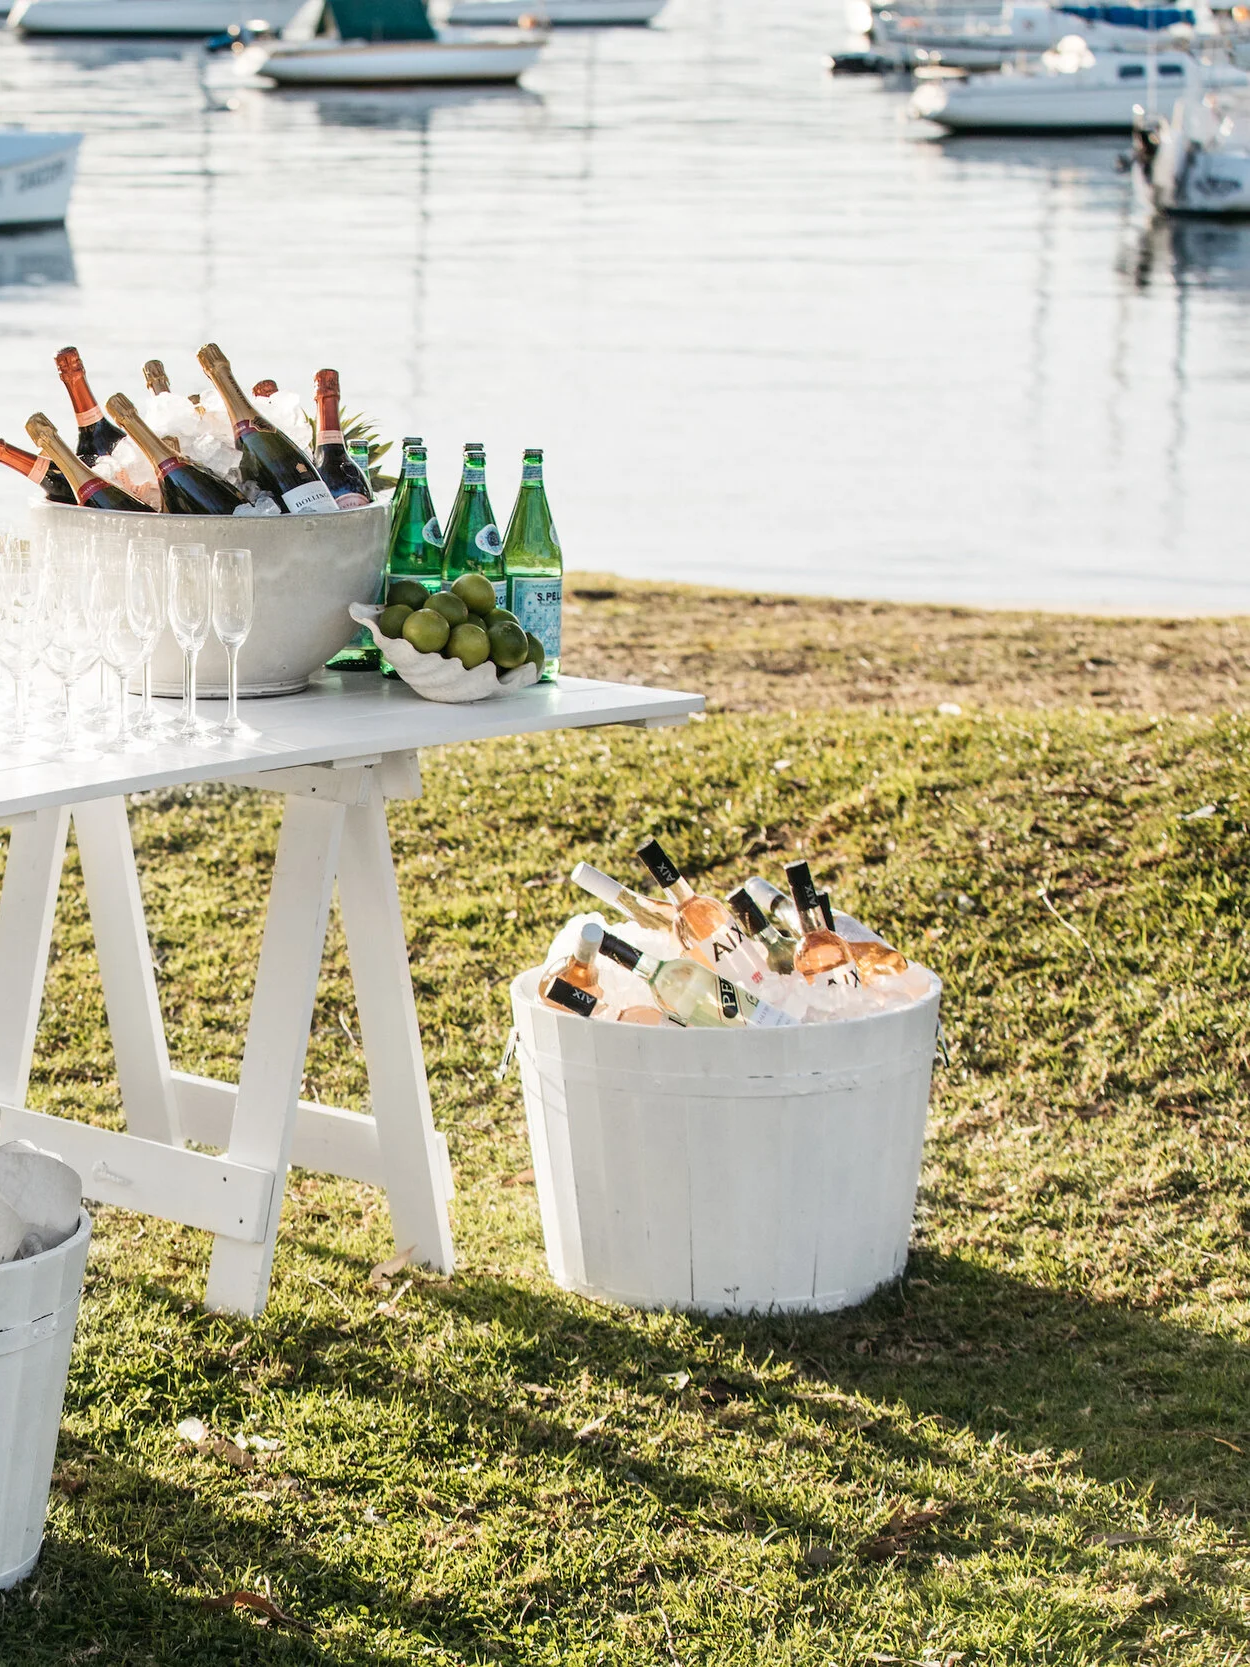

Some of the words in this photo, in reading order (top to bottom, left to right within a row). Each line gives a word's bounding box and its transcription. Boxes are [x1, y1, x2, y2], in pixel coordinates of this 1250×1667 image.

[656, 861, 676, 883] AIX
[712, 923, 746, 962] AIX
[572, 988, 595, 1004] AIX
